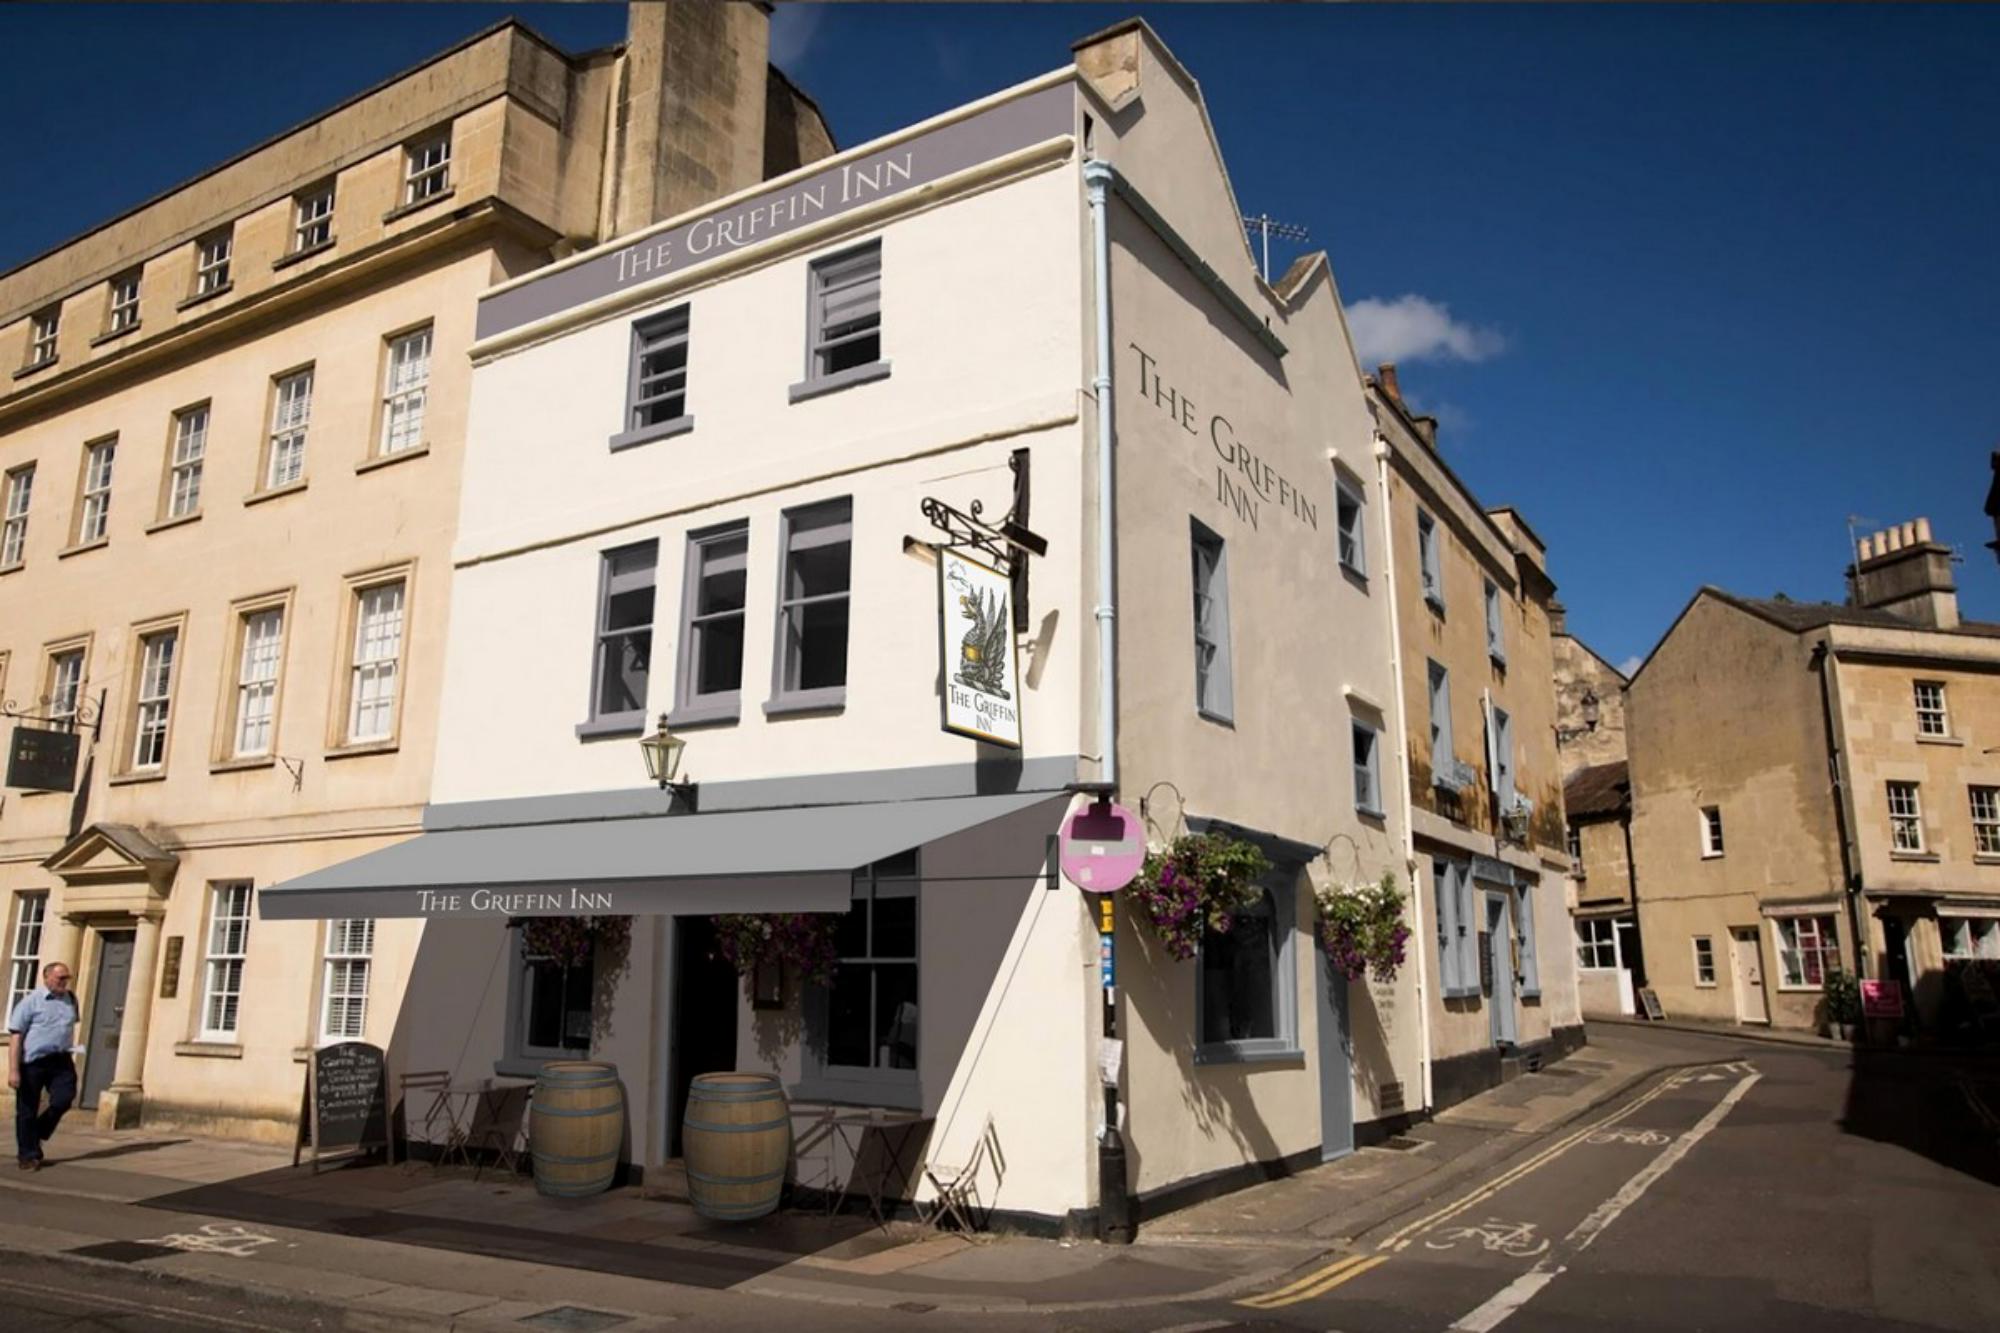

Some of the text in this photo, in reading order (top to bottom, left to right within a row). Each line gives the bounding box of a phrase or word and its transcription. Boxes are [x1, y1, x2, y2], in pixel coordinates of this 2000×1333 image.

[612, 152, 913, 282] THE GRIFFIN INN
[1129, 342, 1318, 531] THE GRIFFIN
[1217, 466, 1259, 532] INN
[948, 684, 1016, 722] THE GRIFFIN
[975, 714, 992, 733] INN
[416, 888, 613, 915] THE GRIFFIN INN
